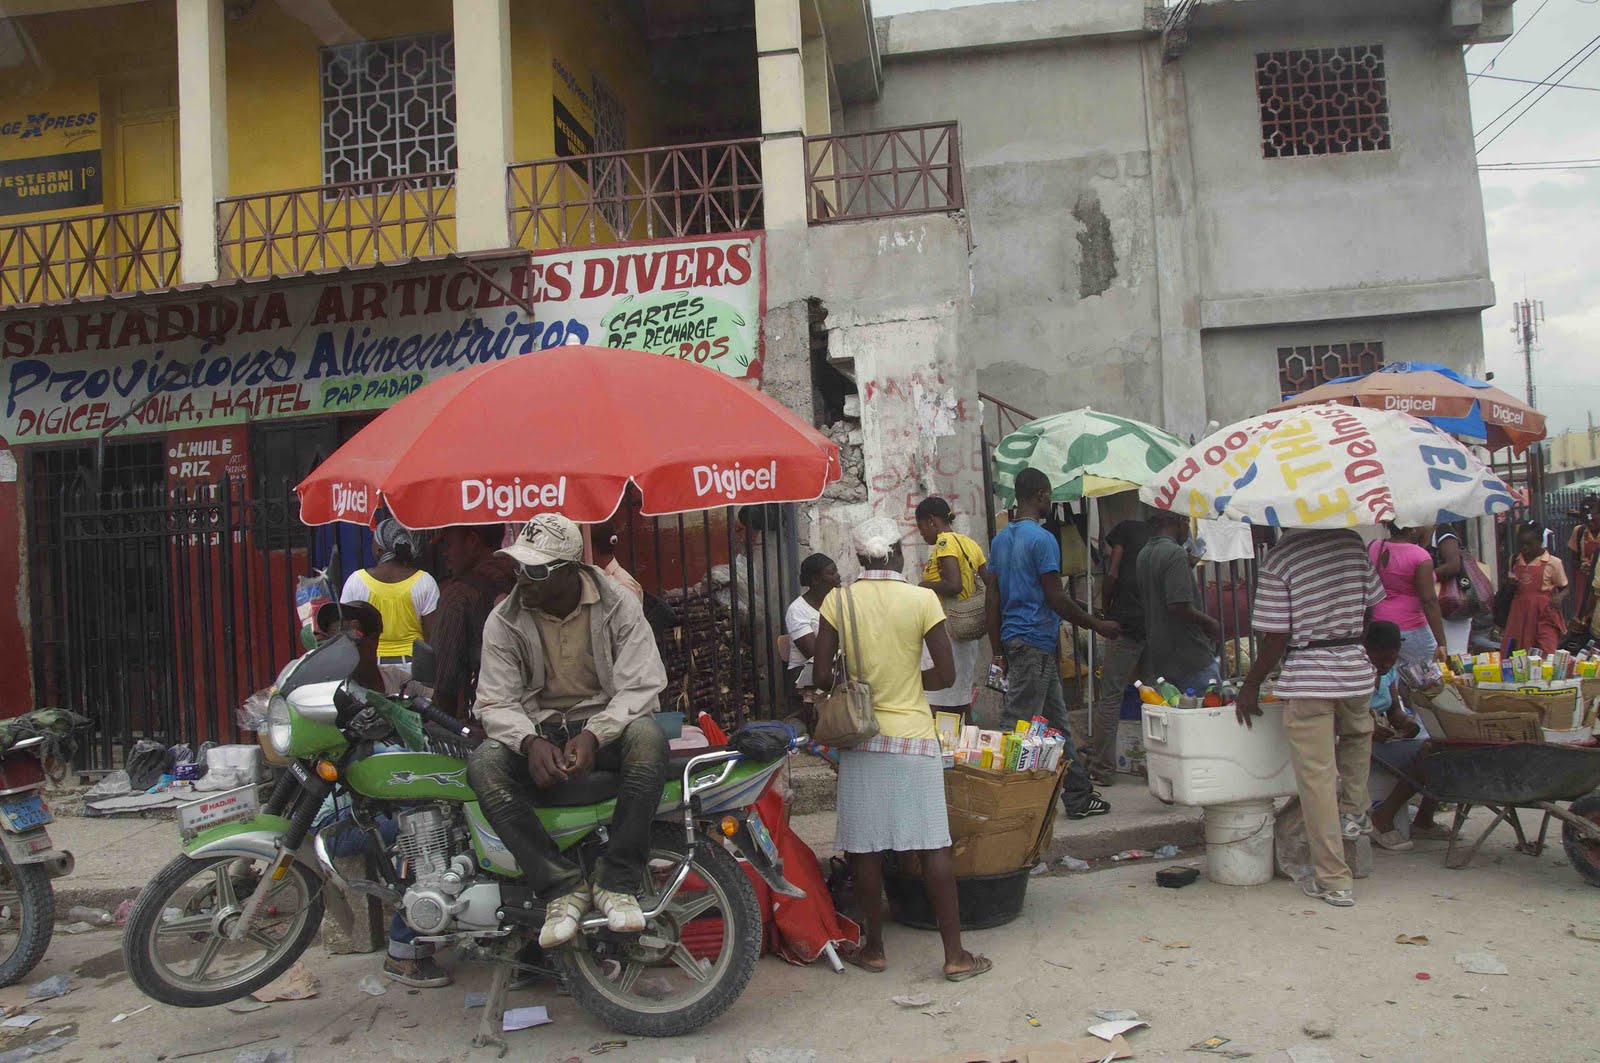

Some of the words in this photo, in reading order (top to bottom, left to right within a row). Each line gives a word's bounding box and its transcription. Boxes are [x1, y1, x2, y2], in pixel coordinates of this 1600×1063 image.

[0, 122, 22, 136] GE
[18, 181, 70, 197] UNION
[310, 259, 573, 326] ARTICLES
[582, 243, 753, 300] DIVERS
[609, 296, 705, 332] CARTES
[607, 331, 637, 349] DE
[643, 316, 718, 350] RECHARGE
[209, 383, 311, 419] HAITEL
[1384, 395, 1436, 412] Digicel
[176, 439, 233, 458] L'HUILE
[180, 460, 211, 478] RIZ
[692, 460, 777, 499] Digicel
[461, 476, 567, 517] Digicel
